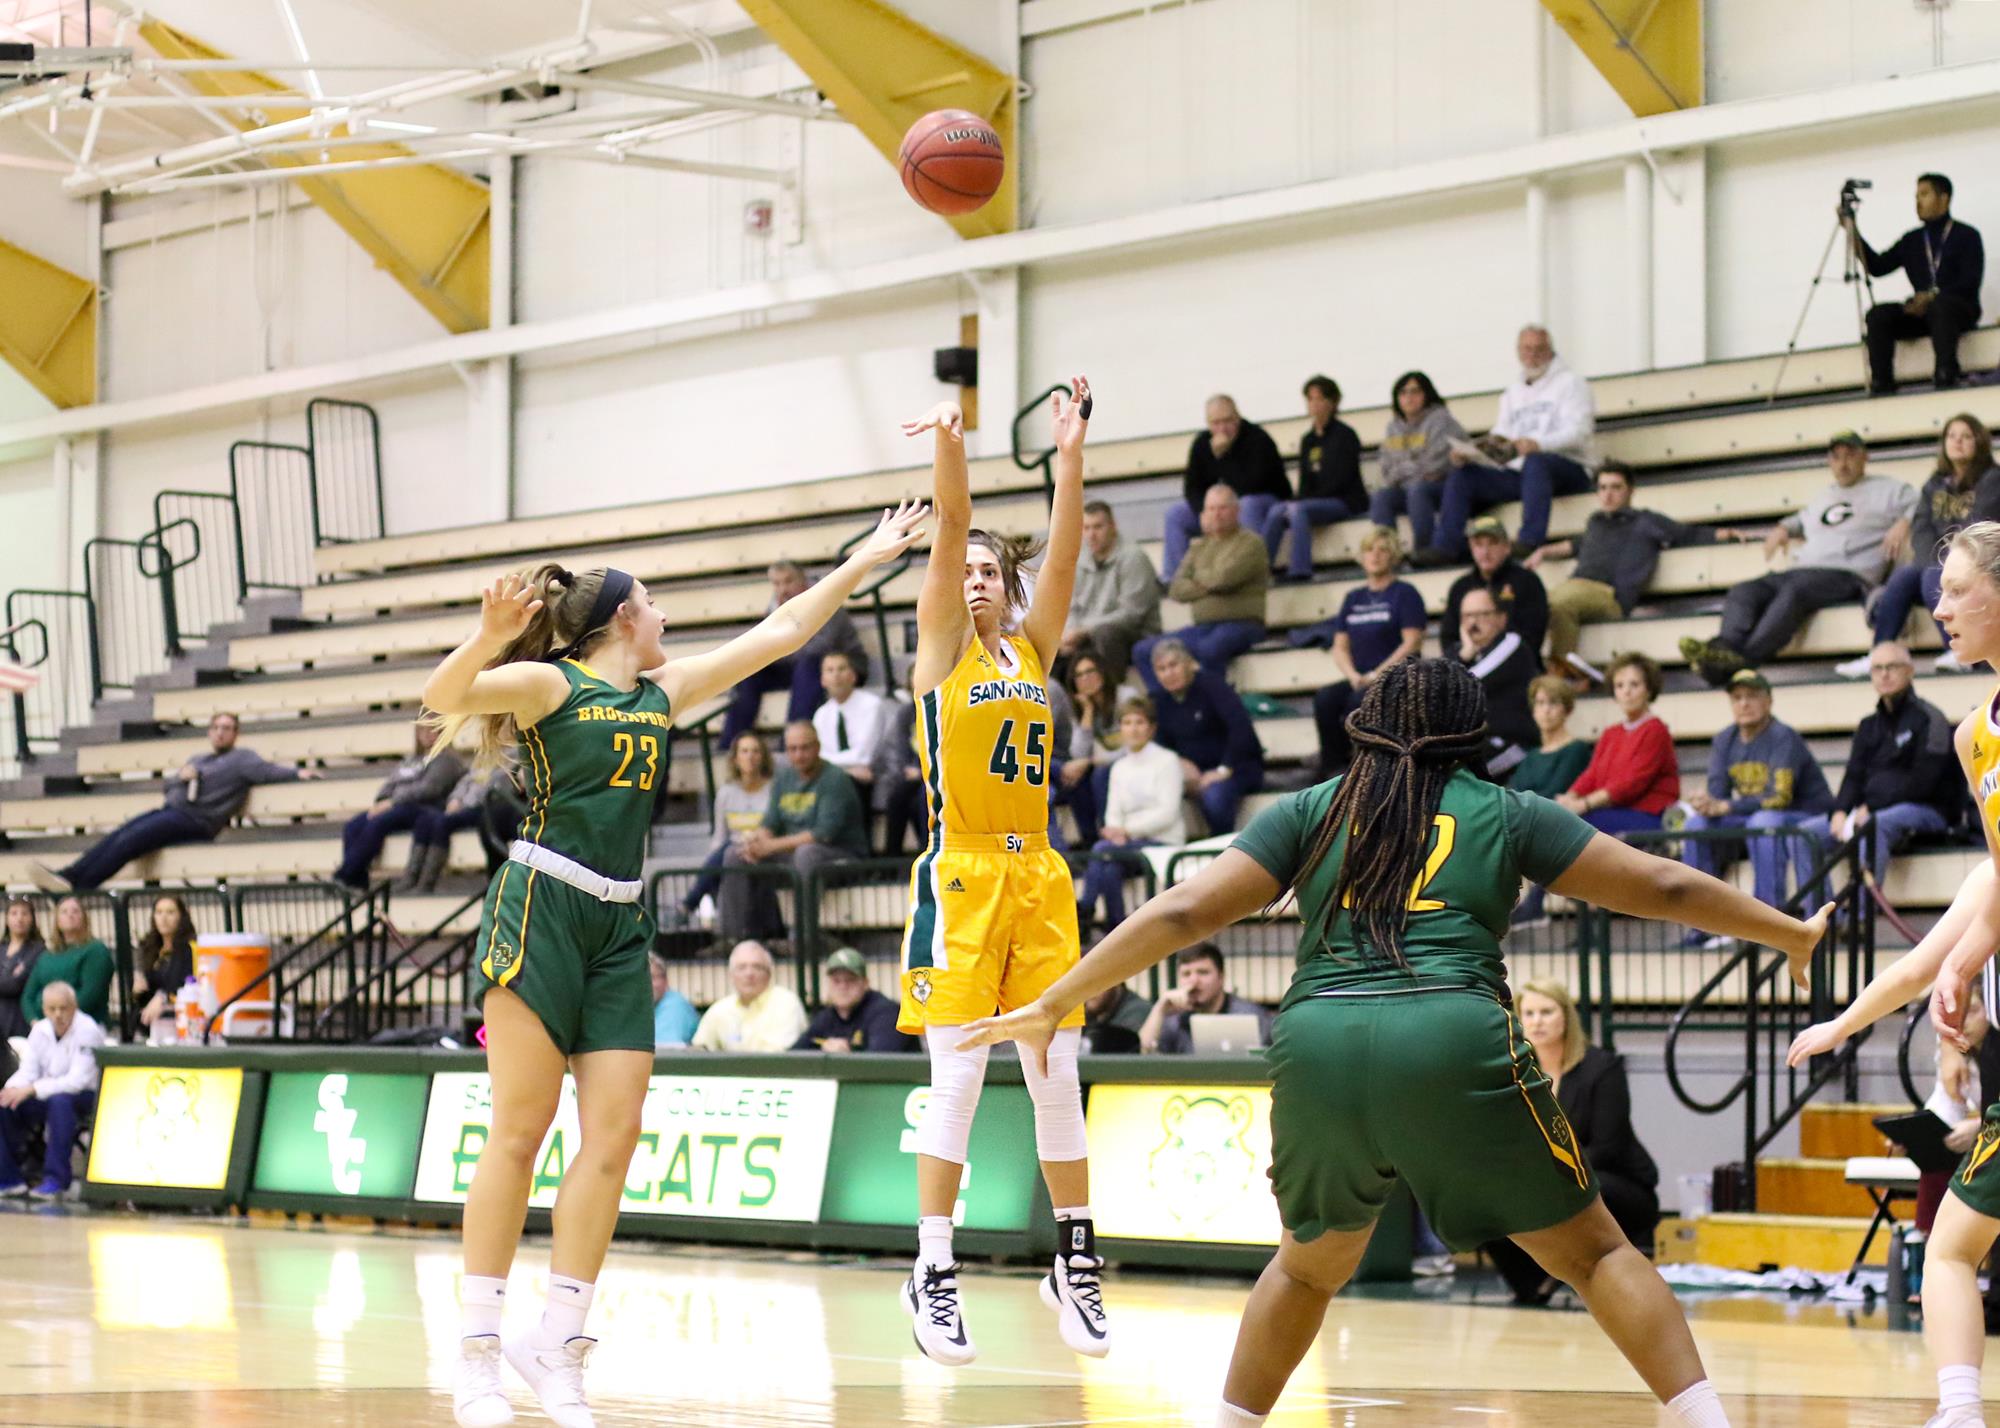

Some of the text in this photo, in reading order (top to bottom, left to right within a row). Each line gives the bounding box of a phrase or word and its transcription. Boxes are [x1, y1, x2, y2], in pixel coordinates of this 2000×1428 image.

[608, 732, 660, 791] 23
[989, 718, 1047, 786] 45
[1005, 834, 1023, 853] SV
[451, 1121, 783, 1208] BACATS
